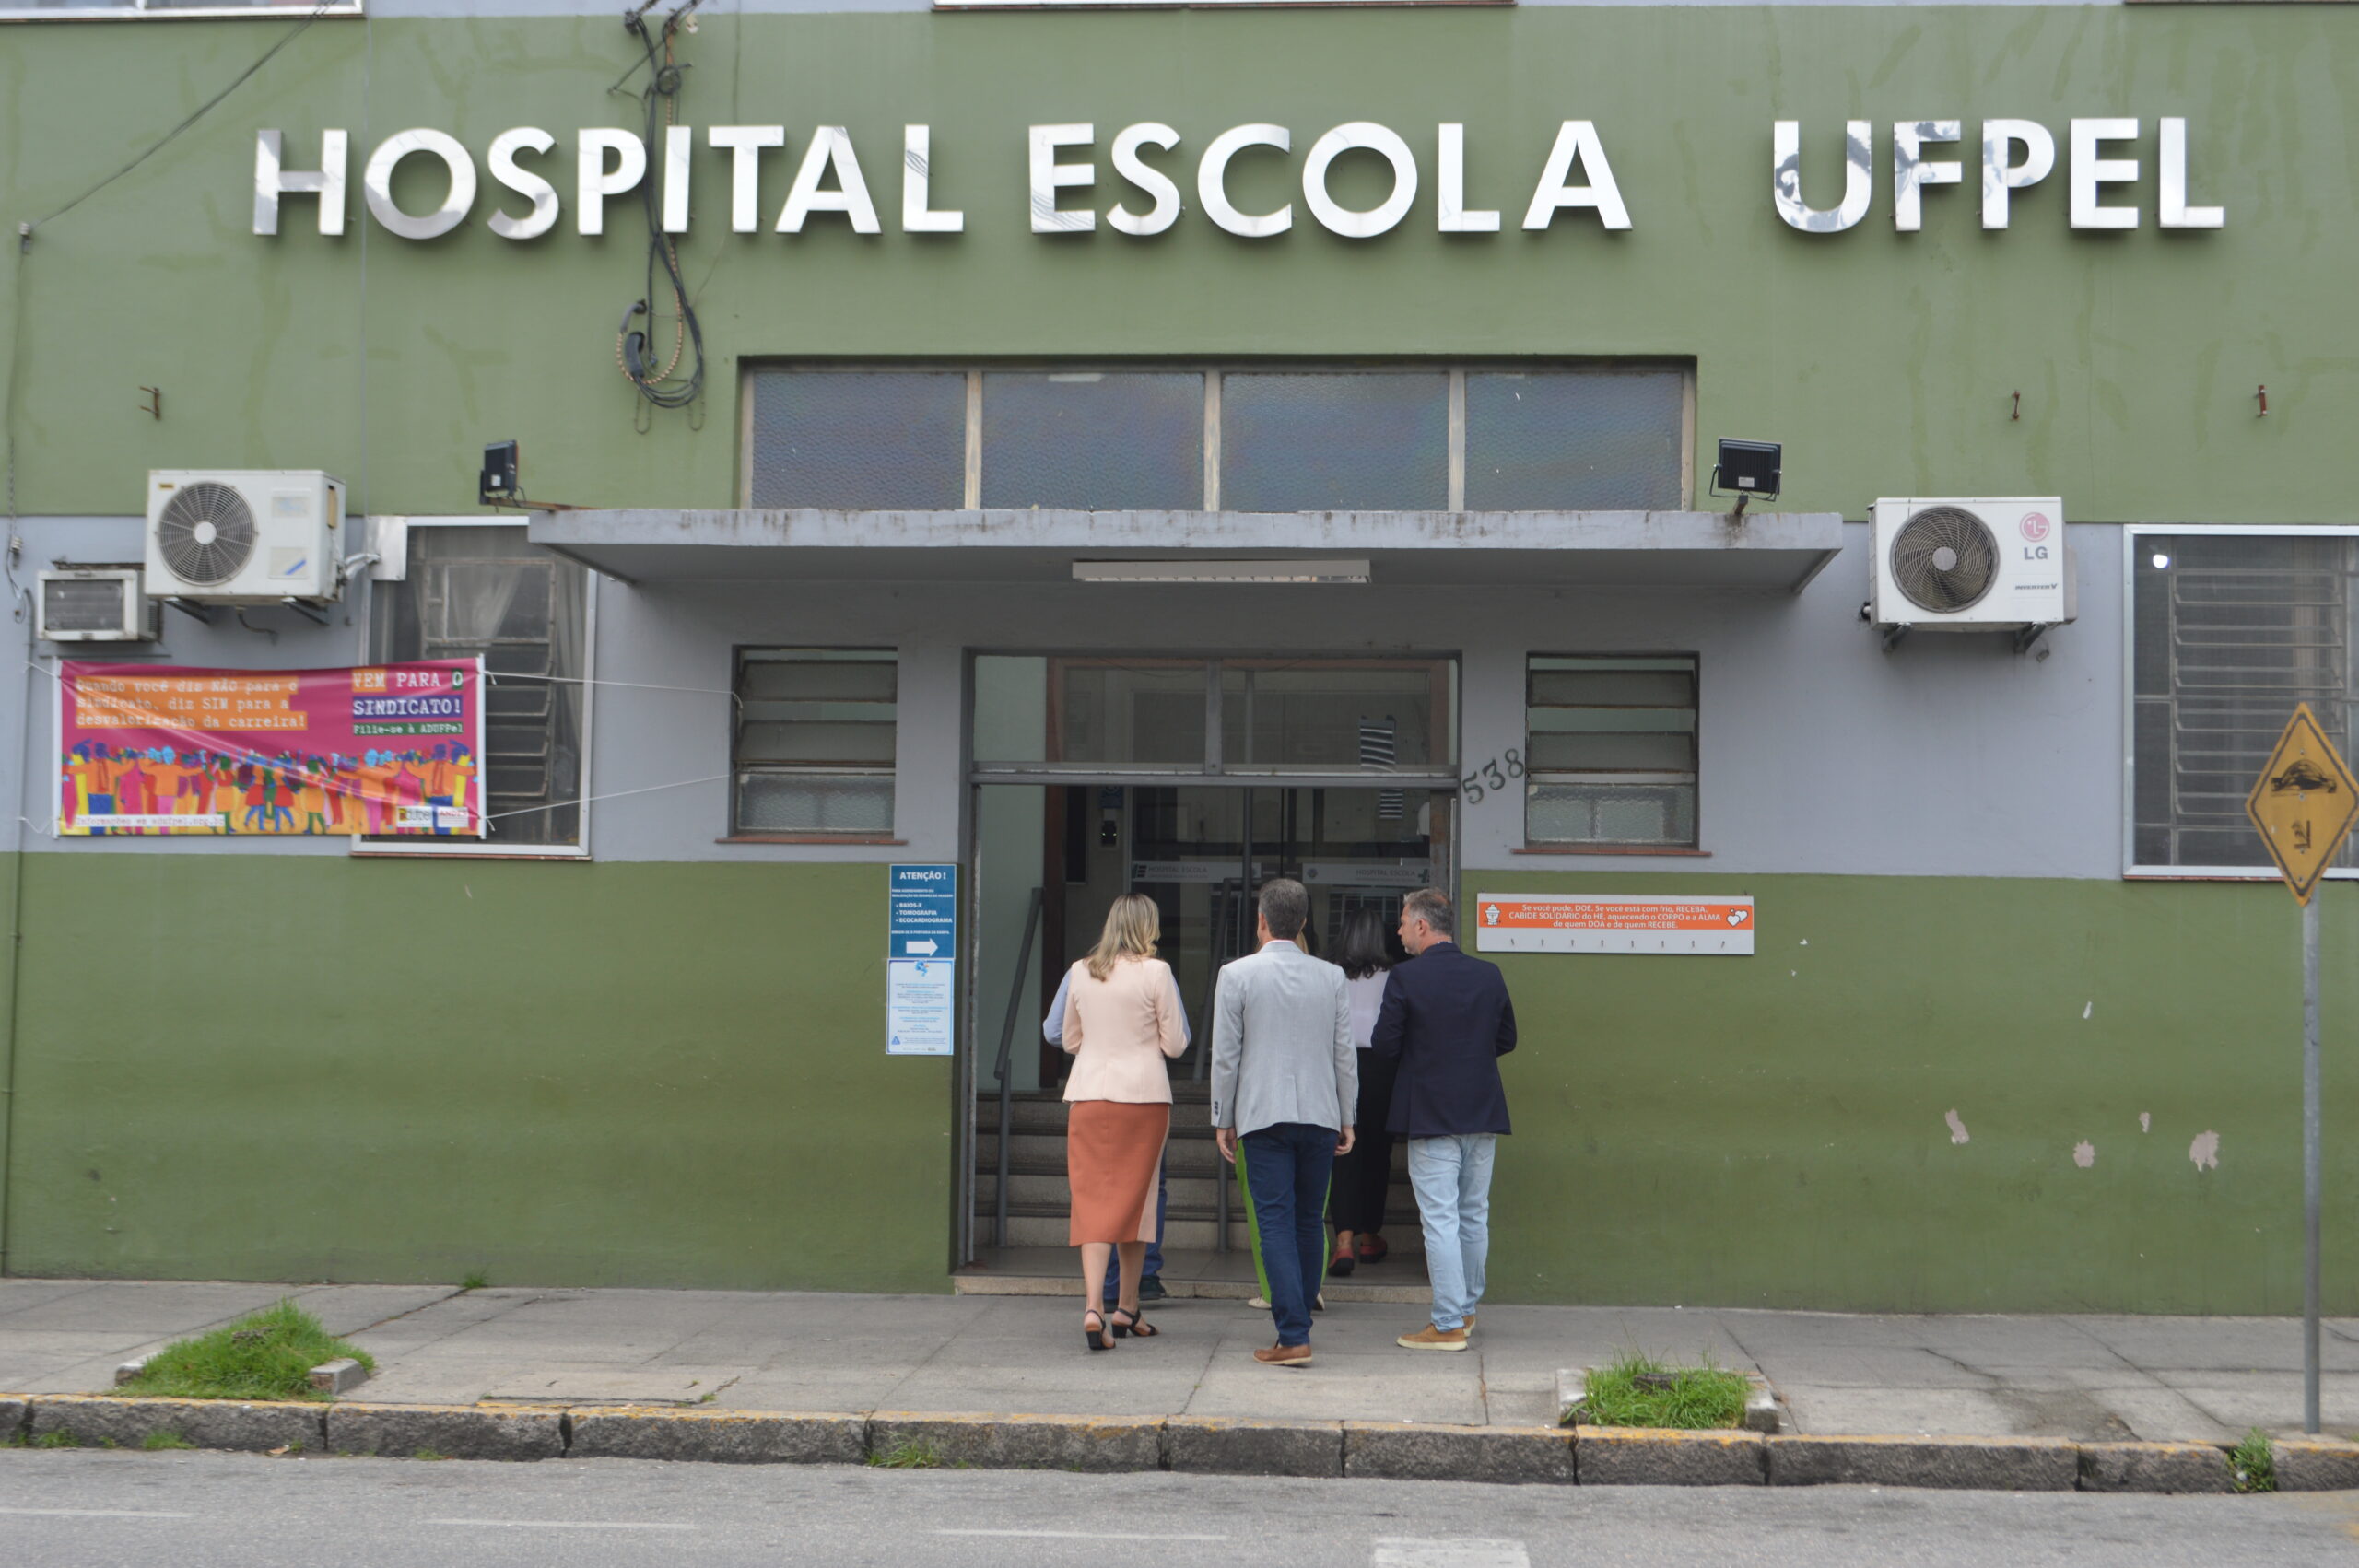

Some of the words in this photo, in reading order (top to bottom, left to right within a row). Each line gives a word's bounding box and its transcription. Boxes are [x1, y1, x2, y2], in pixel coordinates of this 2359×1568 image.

[253, 124, 964, 240] HOSPITAL
[1028, 120, 1633, 238] ESCOLA
[1774, 117, 2224, 232] UFPEL
[2024, 546, 2048, 560] LG
[76, 679, 125, 692] Quando
[135, 679, 169, 692] você
[177, 680, 204, 692] diz
[211, 677, 237, 692] NÃO
[245, 682, 280, 695] para
[288, 682, 298, 692] o
[353, 673, 385, 688] VEM
[396, 672, 441, 687] PARA
[452, 671, 464, 686] O
[169, 697, 194, 710] diz
[203, 697, 229, 710] SIM
[237, 700, 272, 713] para
[280, 700, 289, 710] a
[353, 698, 461, 715] SINDICATO!
[204, 715, 220, 728] da
[229, 715, 305, 728] carreira!
[354, 724, 404, 734] Filie-se
[420, 723, 464, 733] ADUFPel
[1461, 748, 1525, 805] 538
[899, 870, 942, 882] ATENÇÃO
[1607, 913, 1649, 922] aquecendo
